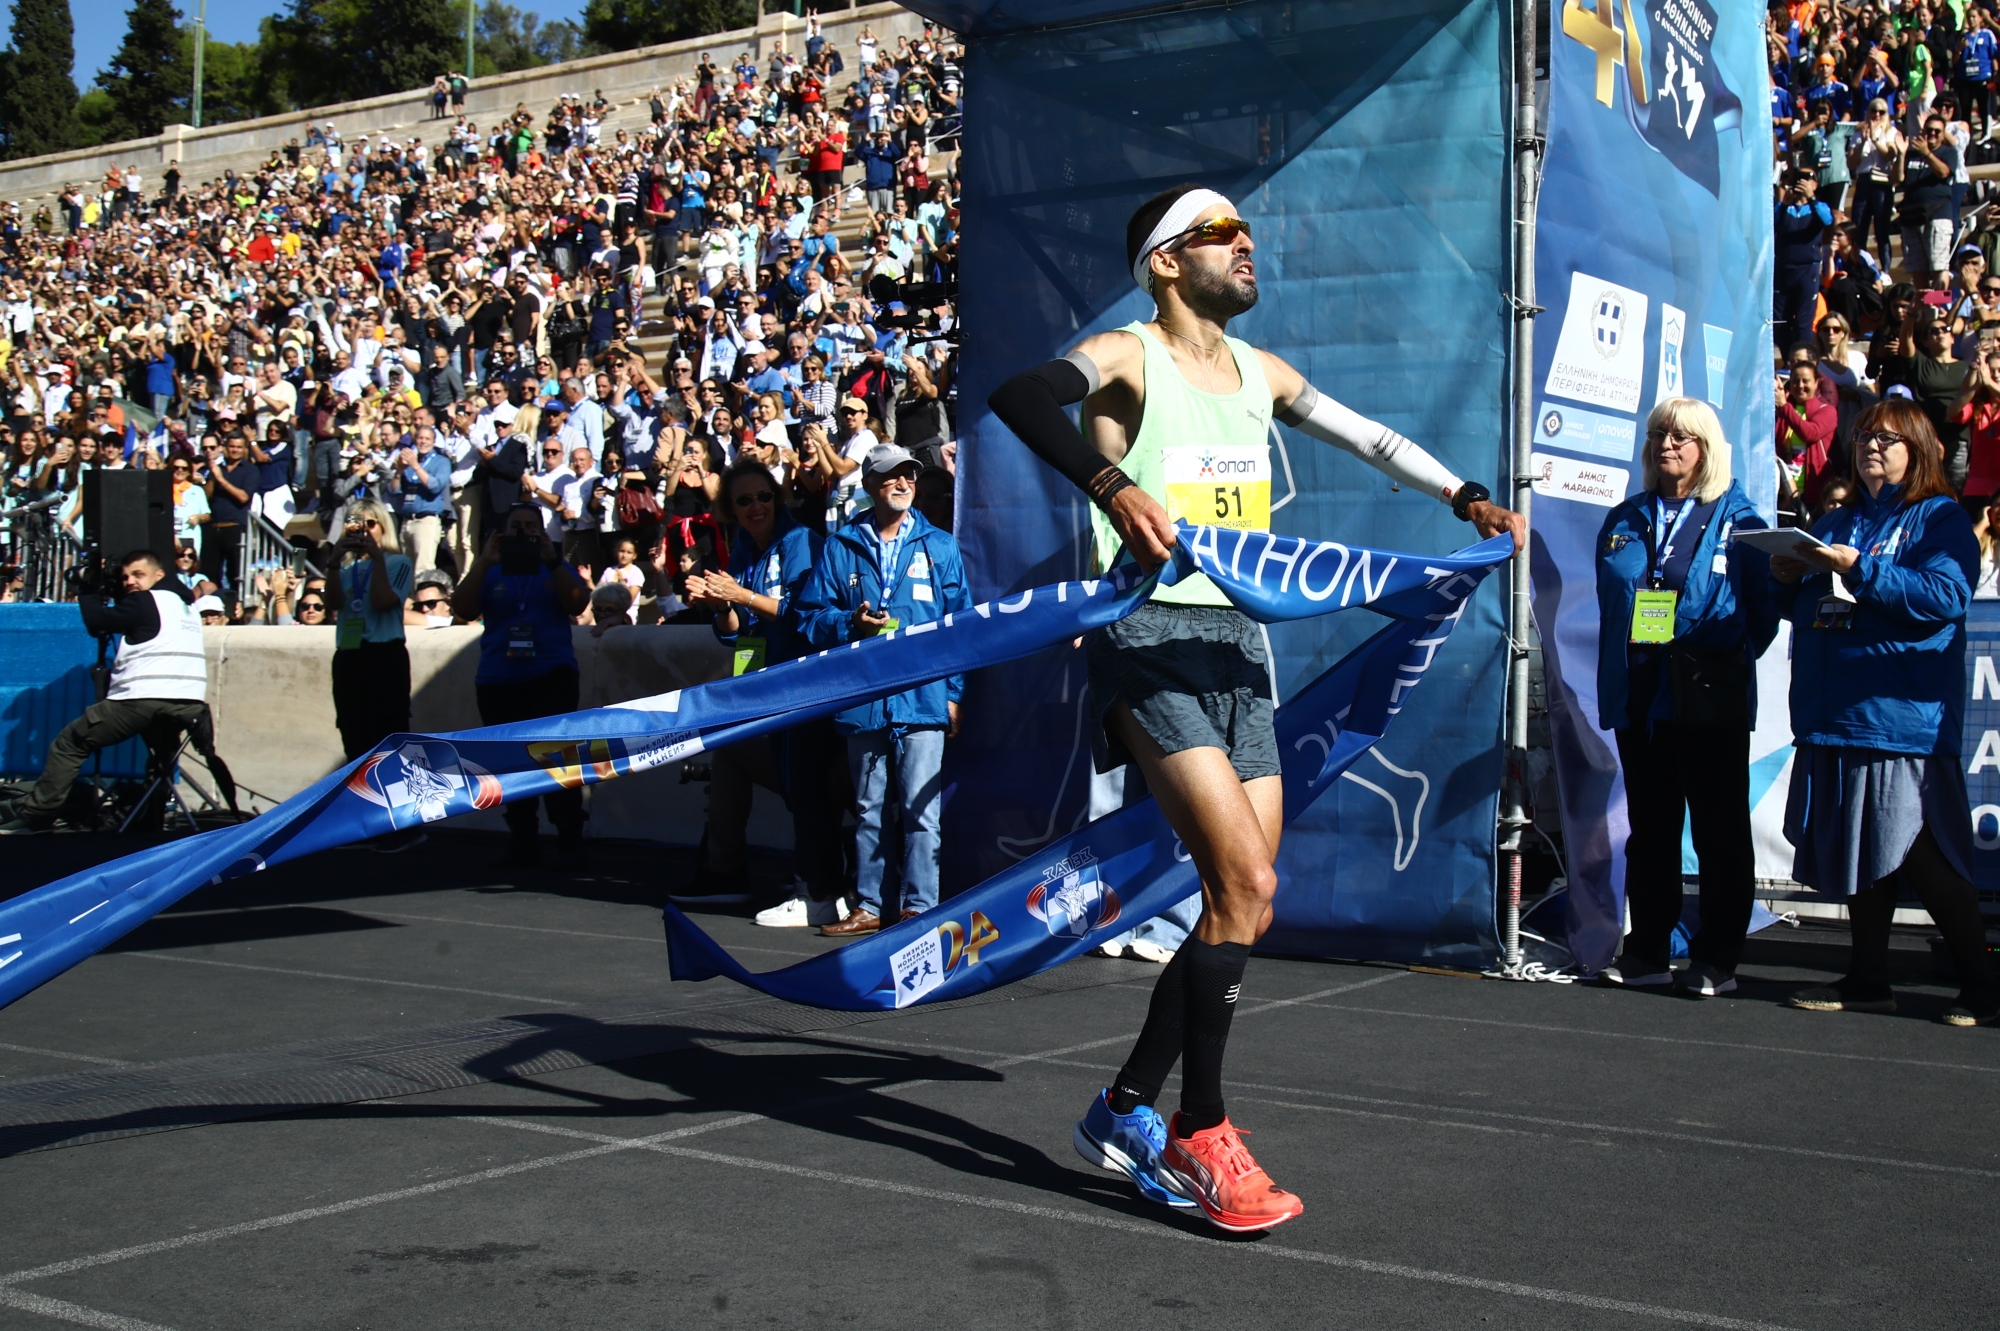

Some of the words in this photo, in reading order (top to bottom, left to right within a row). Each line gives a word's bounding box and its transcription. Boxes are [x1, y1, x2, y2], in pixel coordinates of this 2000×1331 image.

[1663, 0, 1698, 47] ΑΘΗΝΑΣ
[1679, 0, 1712, 41] ΘΩΝΙΟΣ
[1552, 376, 1606, 399] ΠΕΡΙΦΕΡΕΙΑ
[1609, 390, 1638, 406] ΑΤΤΙΚΗΣ
[1556, 362, 1598, 381] ΕΛΛΗΝΙΚΗ
[1600, 373, 1639, 392] ΔΗΜΟΚΡΑΤΙΑ
[1562, 482, 1614, 499] ΜΑΡΑΘΩΝΟΣ
[1578, 470, 1607, 483] ΔΗΜΟΣ
[1215, 486, 1242, 518] 51
[1190, 524, 1398, 607] ATHON
